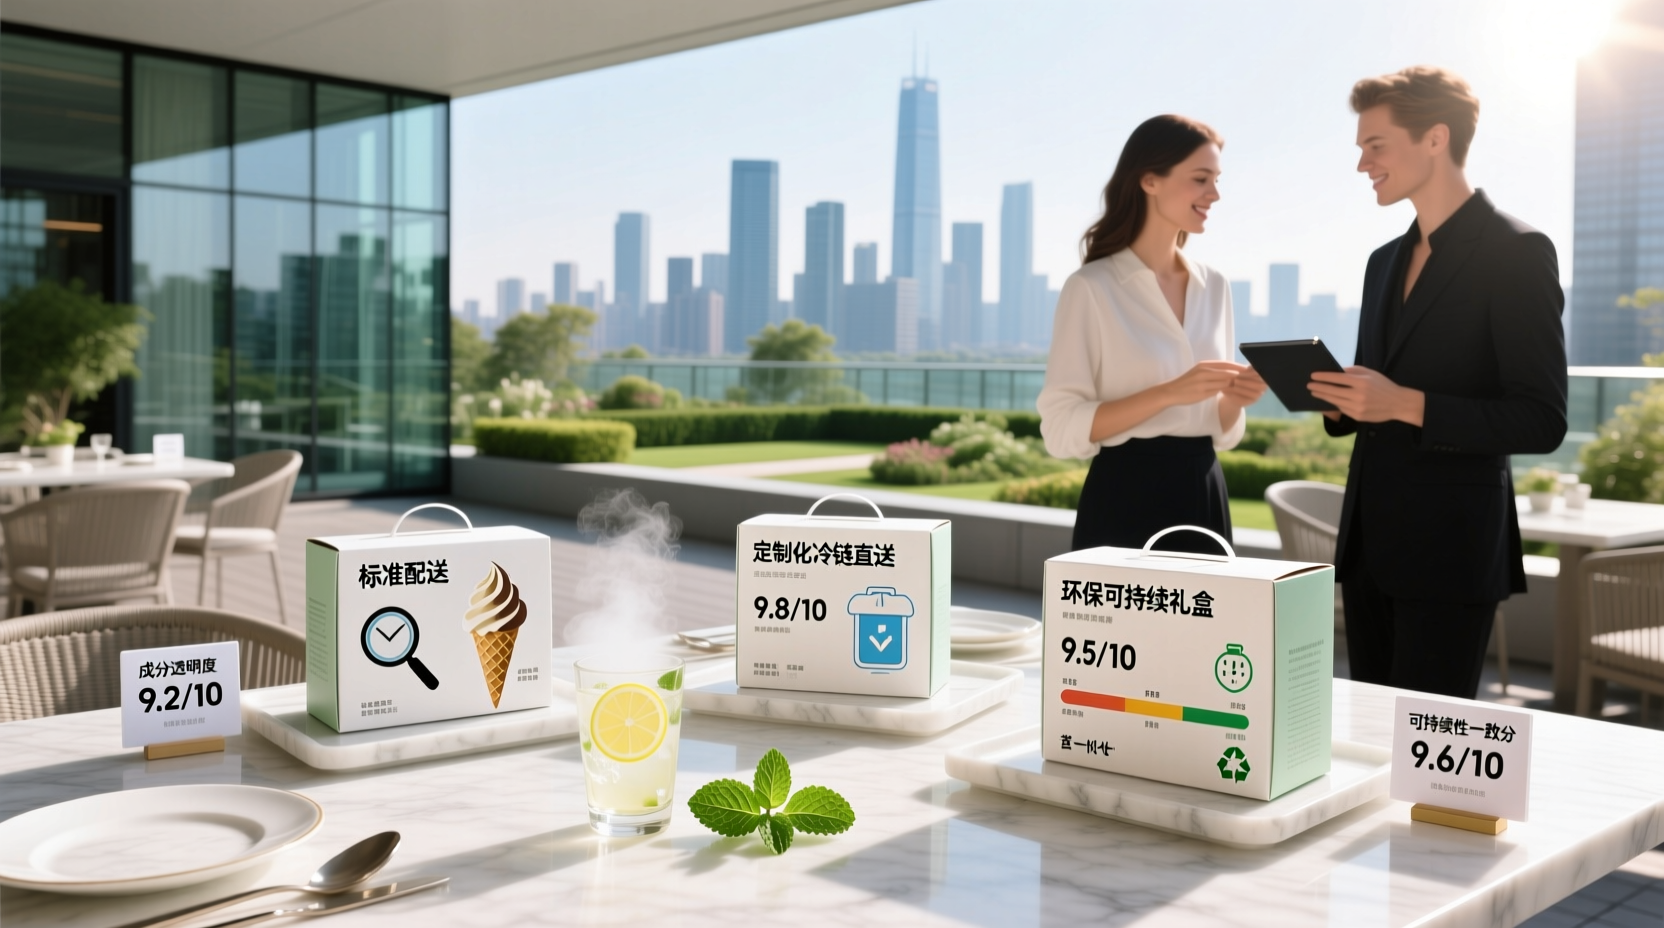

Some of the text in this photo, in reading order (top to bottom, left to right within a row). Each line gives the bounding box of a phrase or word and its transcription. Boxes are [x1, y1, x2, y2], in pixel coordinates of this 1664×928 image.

[753, 539, 896, 568] 定制化冷链直送
[358, 558, 450, 589] 标准配送
[754, 595, 827, 621] 9.8/10
[1061, 579, 1215, 618] 环保可持续礼盒
[138, 657, 218, 679] 成分透明度
[1061, 636, 1137, 671] 9.5/10
[138, 681, 223, 713] 9.2/10
[1411, 740, 1504, 780] 9.6/10
